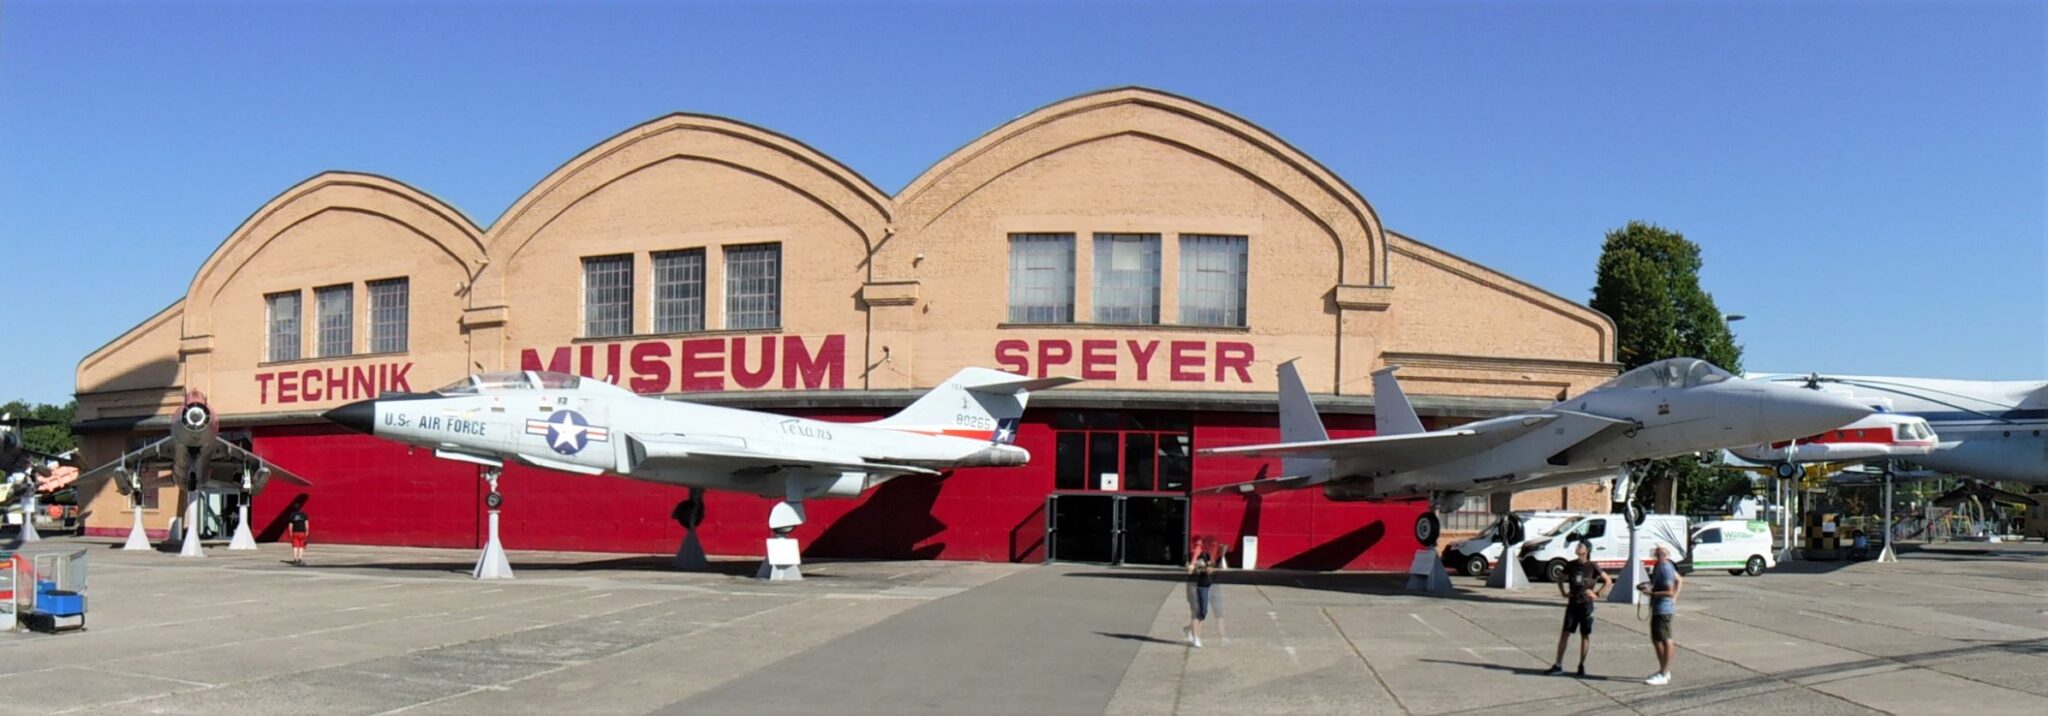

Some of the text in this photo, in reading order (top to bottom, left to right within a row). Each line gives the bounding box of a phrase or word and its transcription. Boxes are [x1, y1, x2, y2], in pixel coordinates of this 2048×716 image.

[255, 334, 1255, 405] TECHNIK MUSEUM SPEYER
[418, 415, 441, 431] AIR
[446, 418, 487, 436] FORCE
[956, 413, 992, 430] 80265
